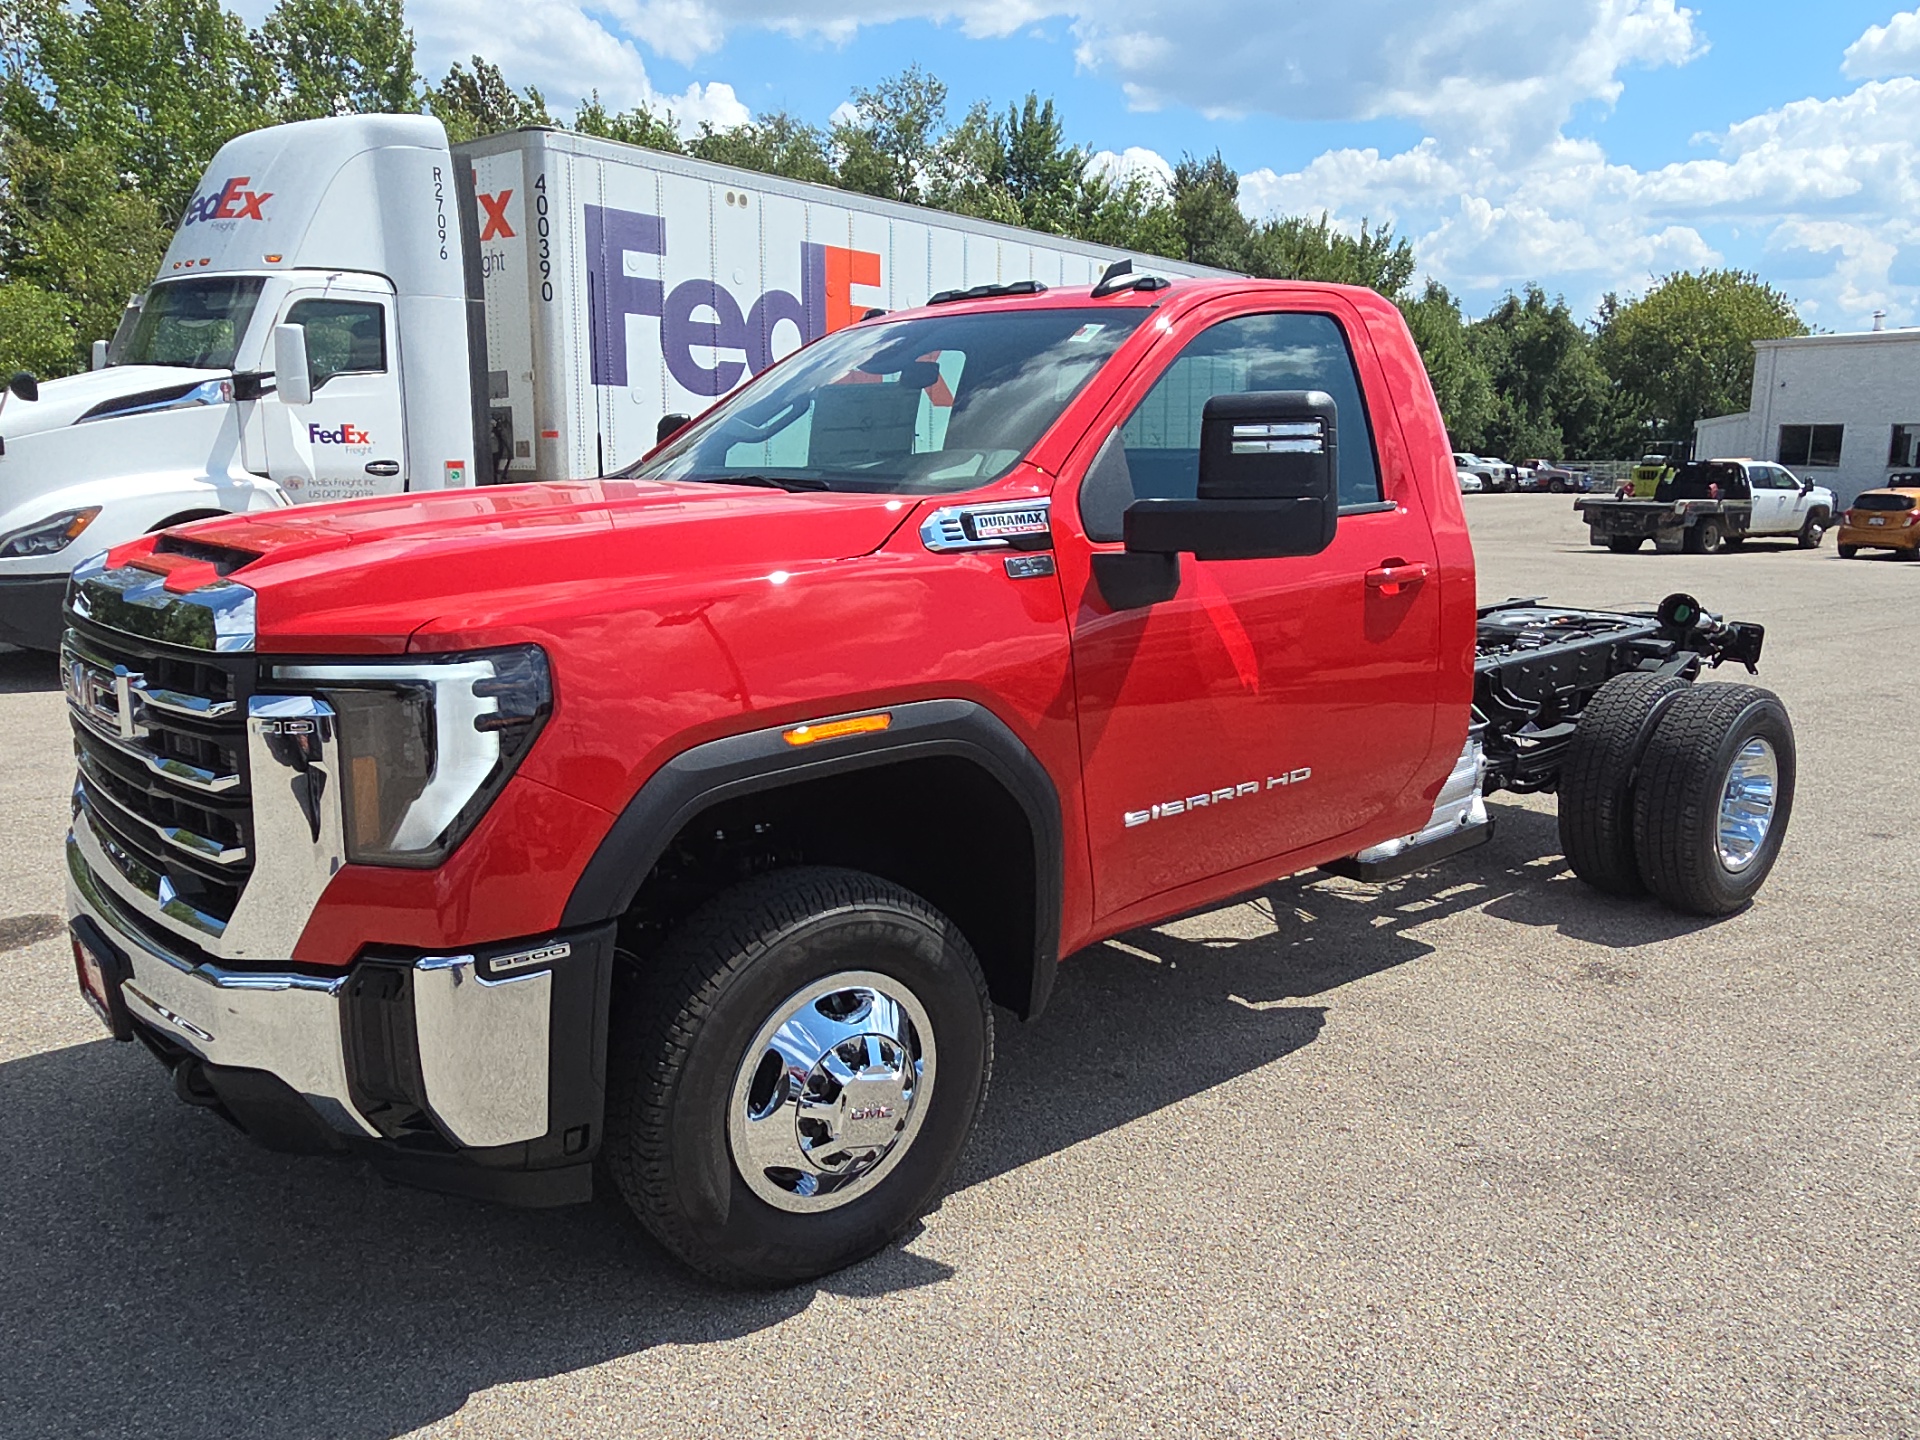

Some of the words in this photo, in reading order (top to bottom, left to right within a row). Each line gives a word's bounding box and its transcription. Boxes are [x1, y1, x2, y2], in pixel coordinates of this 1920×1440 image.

[184, 176, 275, 227] edEx
[432, 166, 448, 260] R27096
[534, 173, 553, 302] 400390
[308, 423, 370, 444] FedEx
[345, 446, 372, 456] Freight
[979, 512, 1043, 528] DURAMAX
[1124, 781, 1259, 828] SIERRA
[1266, 767, 1312, 790] HD
[850, 1106, 895, 1120] GMC
